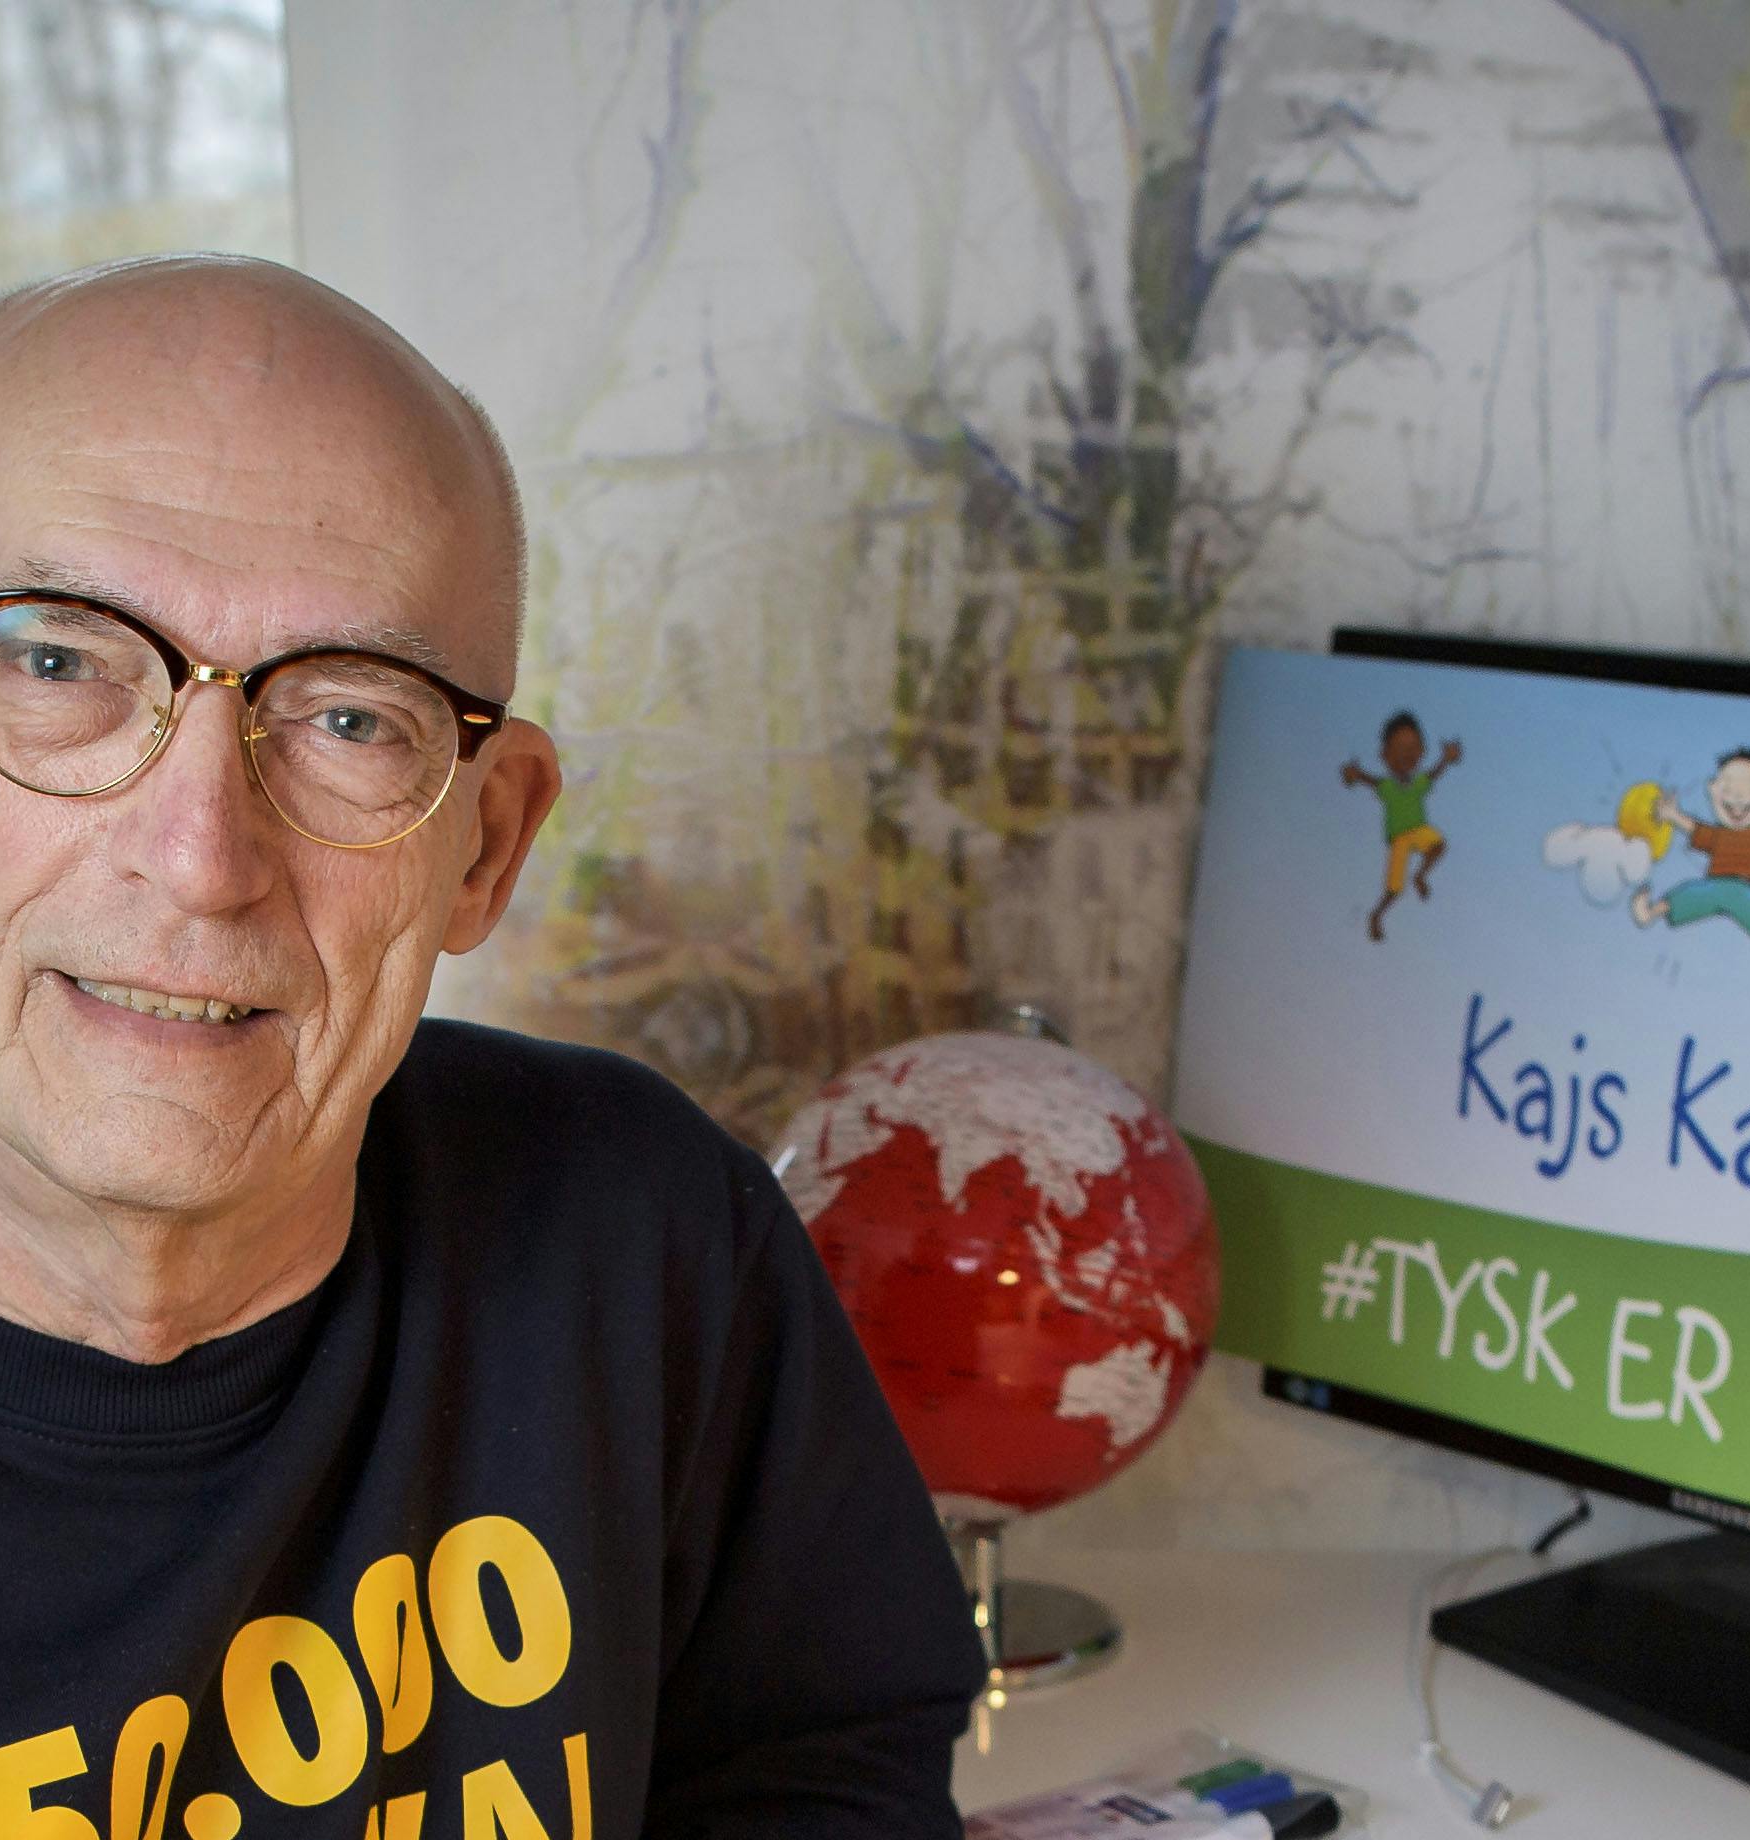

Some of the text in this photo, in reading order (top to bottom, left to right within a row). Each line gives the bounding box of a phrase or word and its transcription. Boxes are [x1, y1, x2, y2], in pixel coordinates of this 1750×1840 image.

[1456, 994, 1627, 1177] Kajs
[1318, 1235, 1575, 1388] #TYSK
[1605, 1299, 1732, 1443] ER
